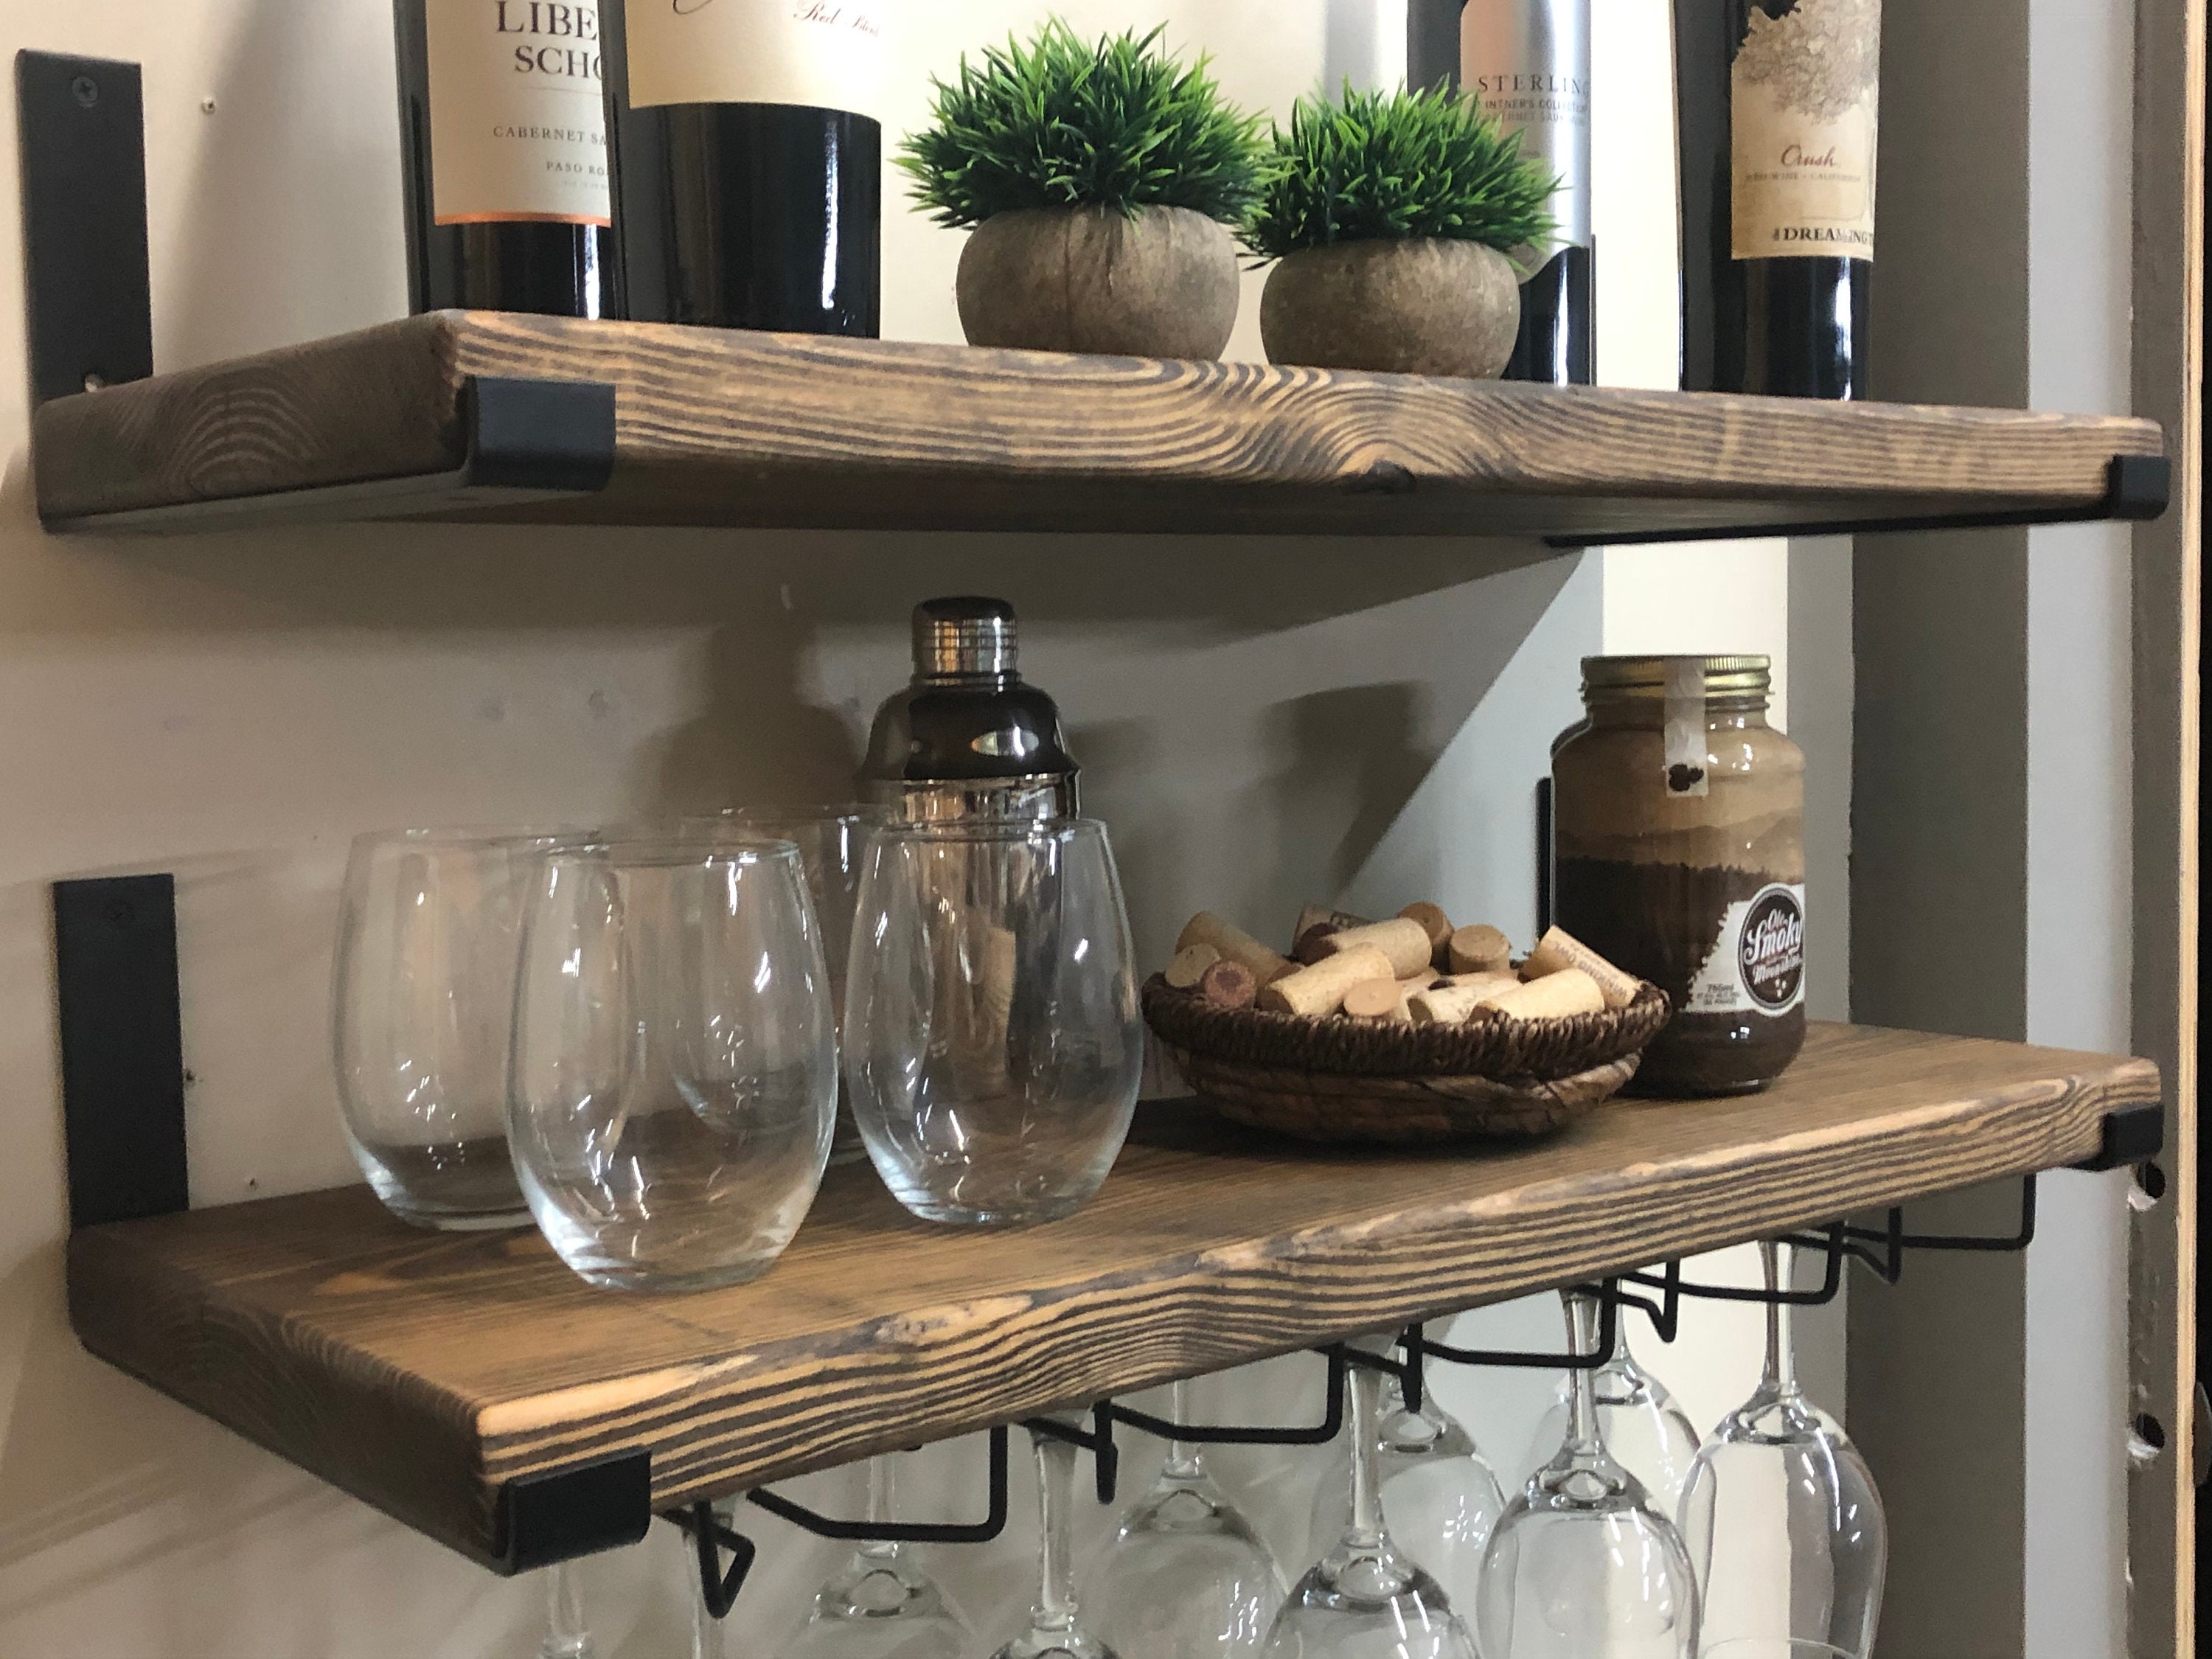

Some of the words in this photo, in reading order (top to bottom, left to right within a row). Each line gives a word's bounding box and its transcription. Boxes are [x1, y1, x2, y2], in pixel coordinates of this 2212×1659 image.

[515, 45, 602, 80] SCH
[493, 125, 585, 142] CABERNET
[546, 161, 582, 173] PASO
[1772, 172, 1798, 180] WINE
